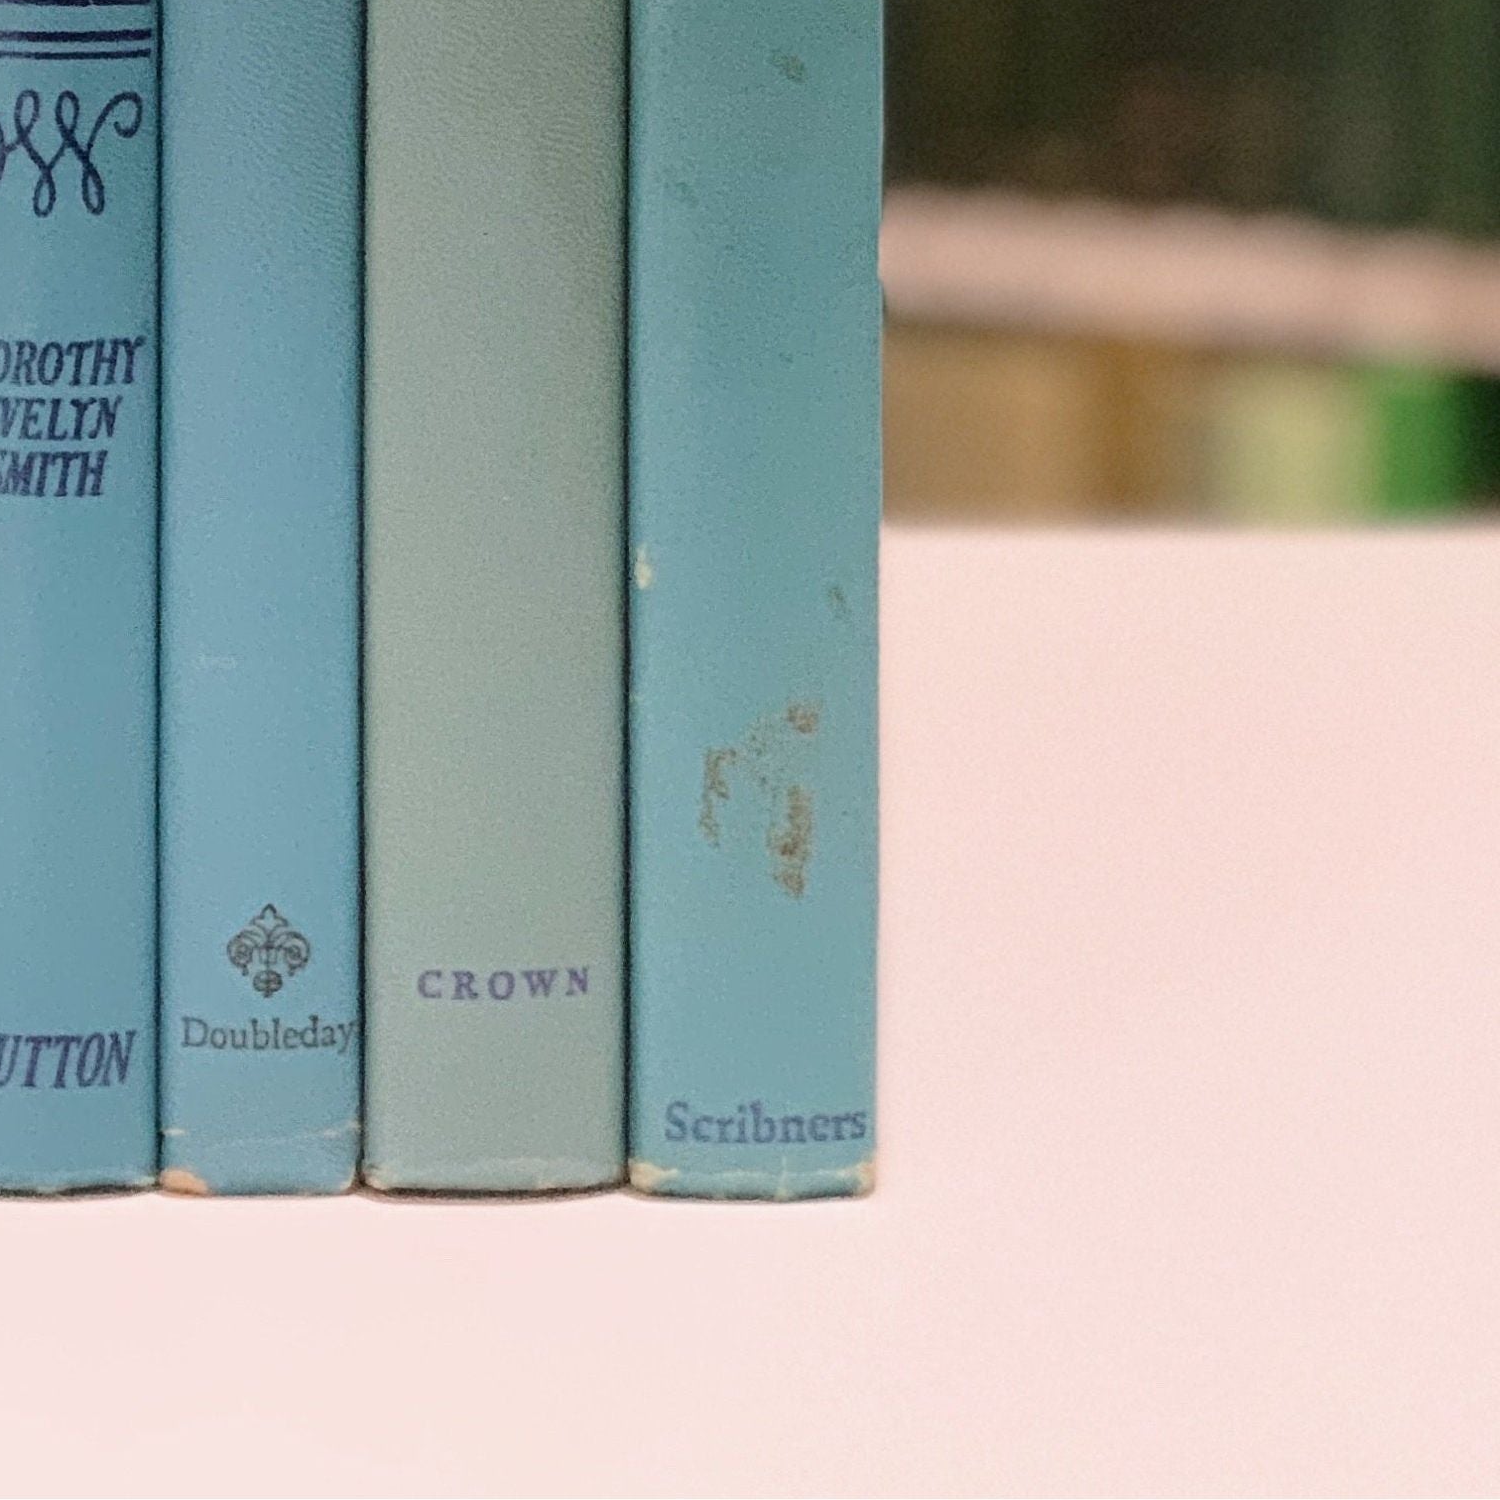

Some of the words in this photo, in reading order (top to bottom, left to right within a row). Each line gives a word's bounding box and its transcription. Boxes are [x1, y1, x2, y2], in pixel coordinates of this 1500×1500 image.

[417, 966, 590, 1002] CROWN
[180, 1014, 358, 1056] Doubleday
[664, 1101, 868, 1146] Scribners
